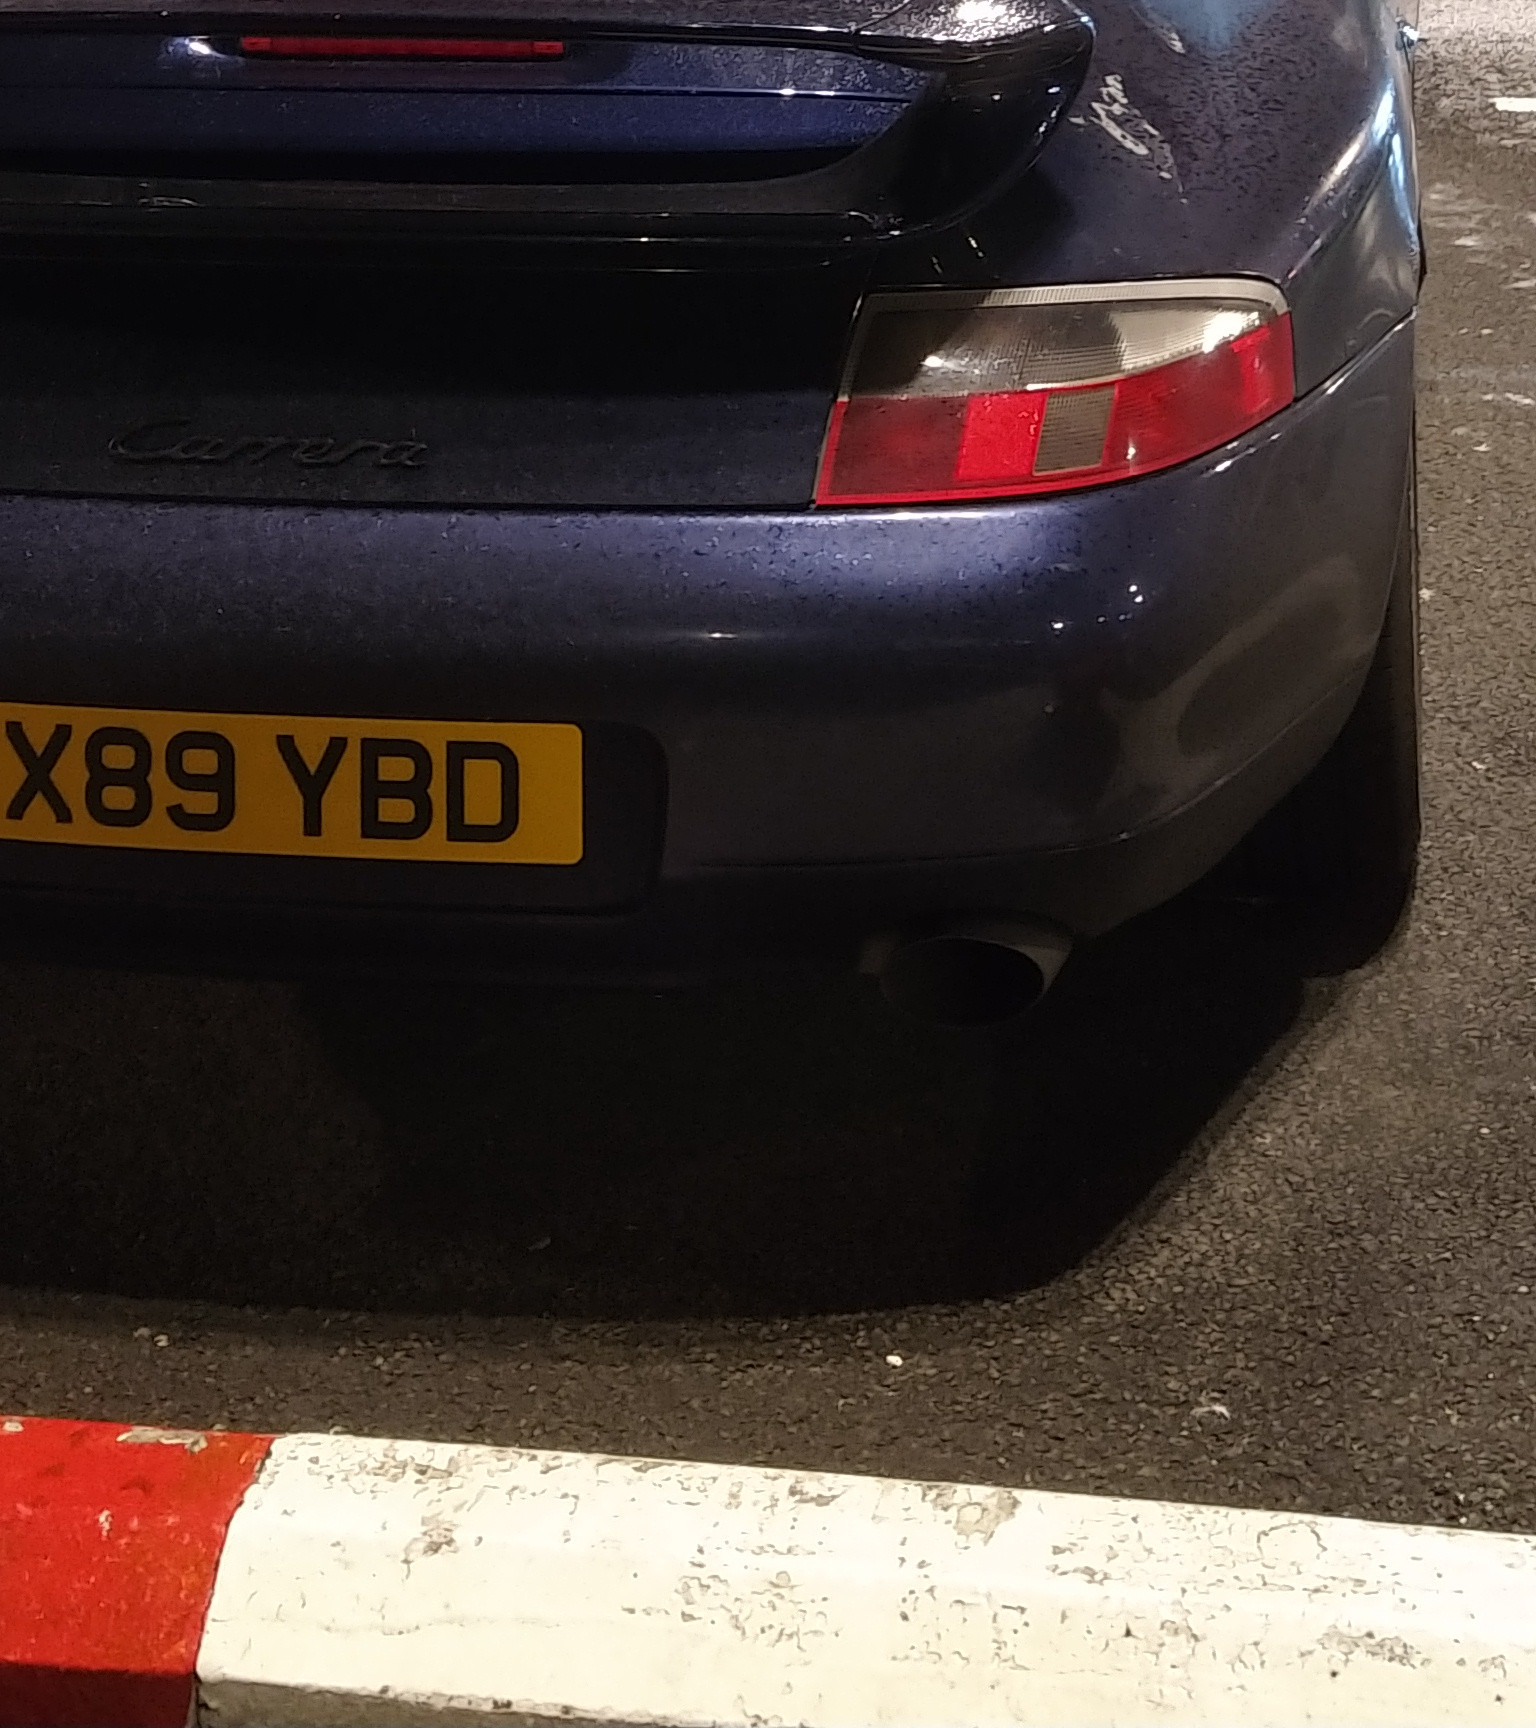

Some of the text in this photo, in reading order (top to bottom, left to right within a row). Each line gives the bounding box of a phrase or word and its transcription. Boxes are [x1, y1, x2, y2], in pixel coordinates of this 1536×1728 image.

[107, 418, 428, 469] Carrera
[4, 720, 520, 844] X89 YBD
